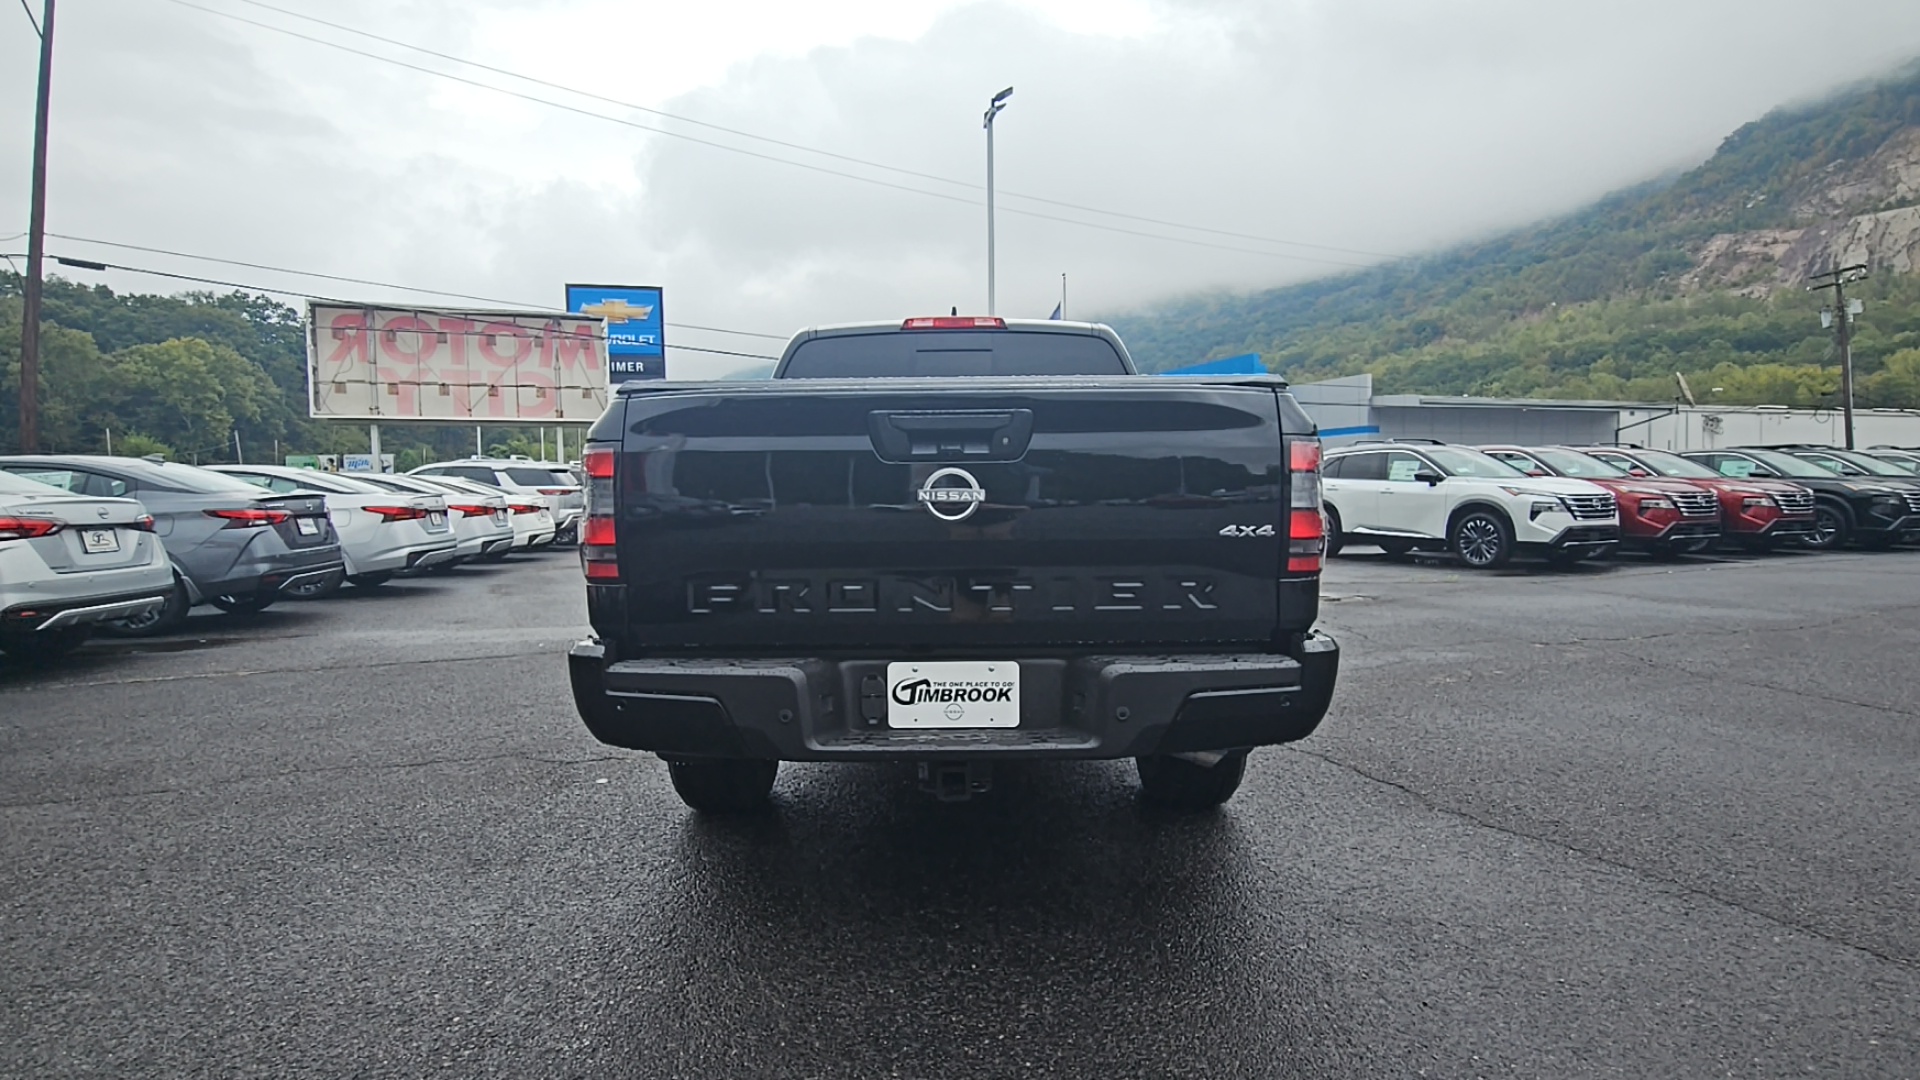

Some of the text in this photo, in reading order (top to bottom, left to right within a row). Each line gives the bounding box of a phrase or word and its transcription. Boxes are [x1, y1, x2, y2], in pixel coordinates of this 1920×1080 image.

[610, 361, 644, 373] IMER
[918, 490, 985, 501] NISSAN
[687, 576, 1218, 613] FRONTIER
[892, 677, 1013, 705] TIMBROOK
